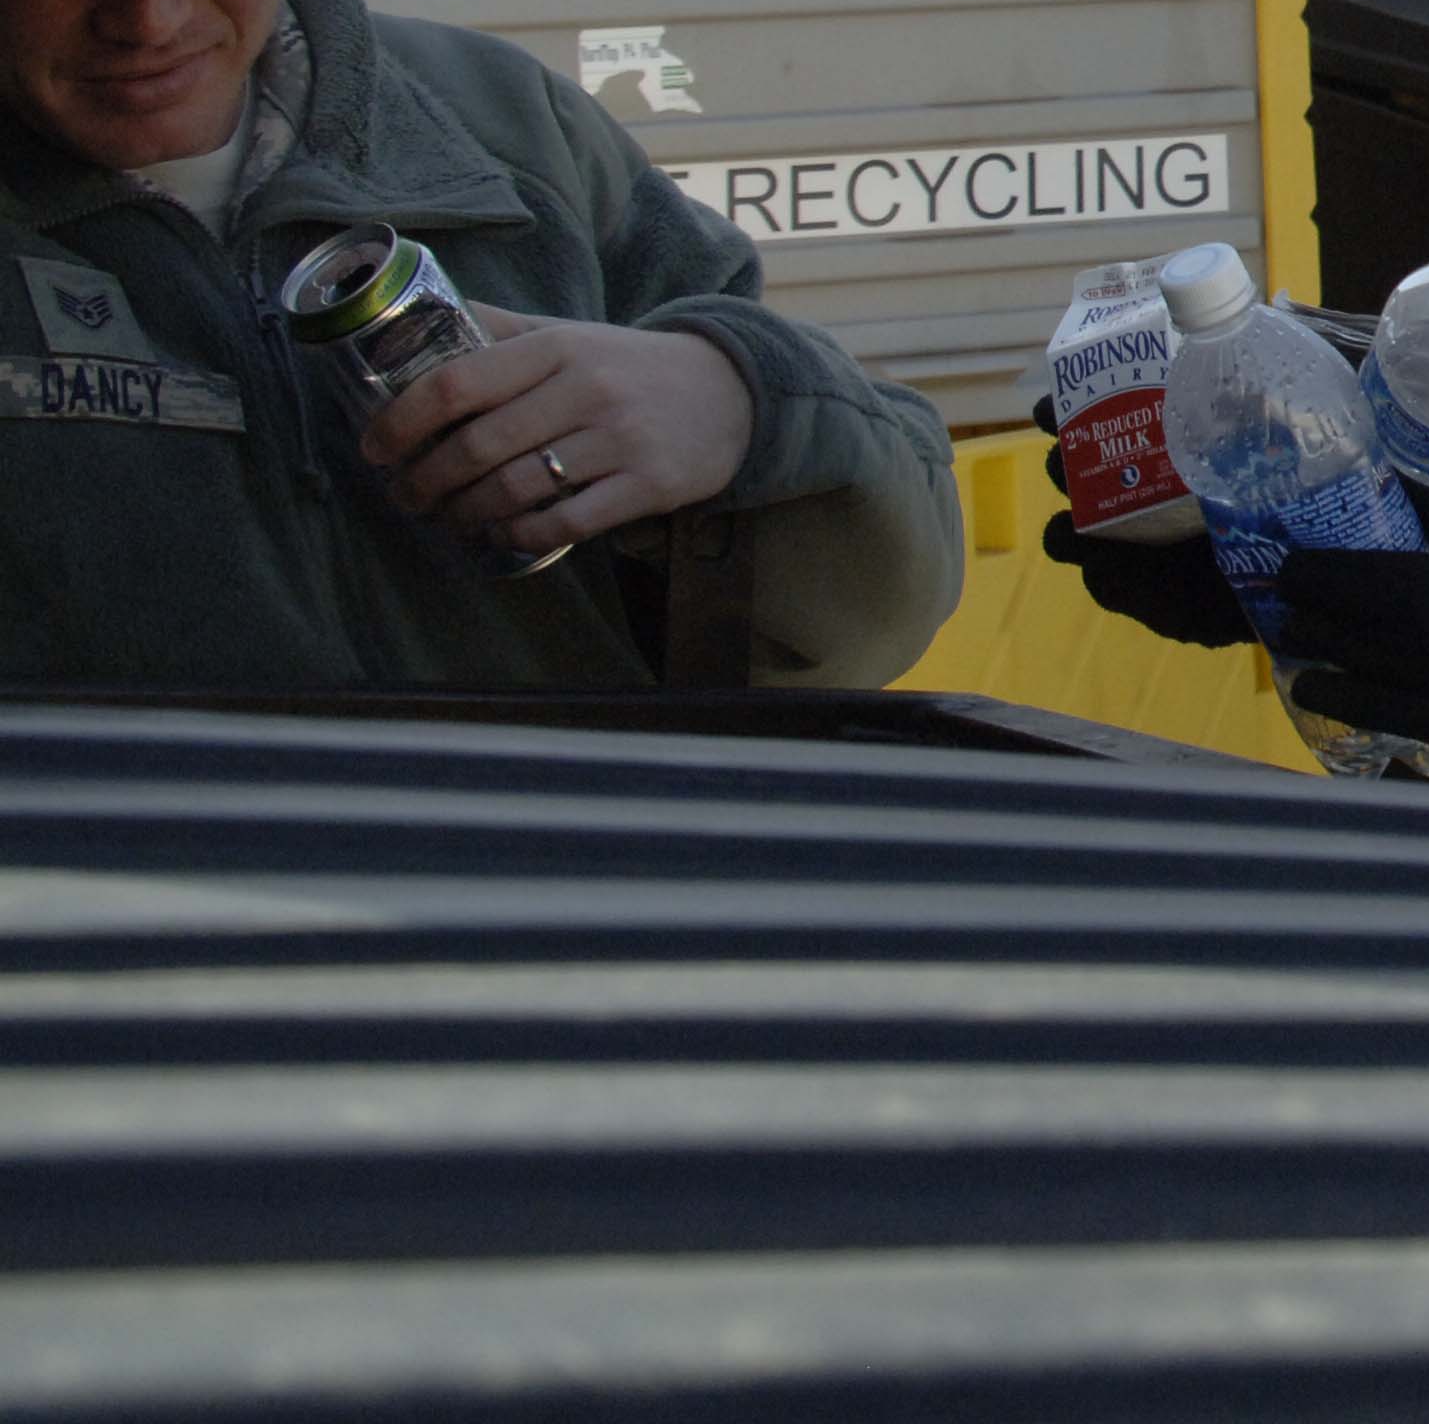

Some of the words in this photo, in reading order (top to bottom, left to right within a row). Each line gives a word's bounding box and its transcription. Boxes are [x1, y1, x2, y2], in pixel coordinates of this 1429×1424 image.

[725, 142, 1211, 233] RECYCLING
[1053, 329, 1169, 398] ROBINSON
[40, 363, 163, 417] DANCY
[1060, 367, 1169, 413] DAIRY
[1065, 427, 1091, 451] 2%
[1091, 407, 1152, 443] REDUCED
[1099, 428, 1151, 460] MILK
